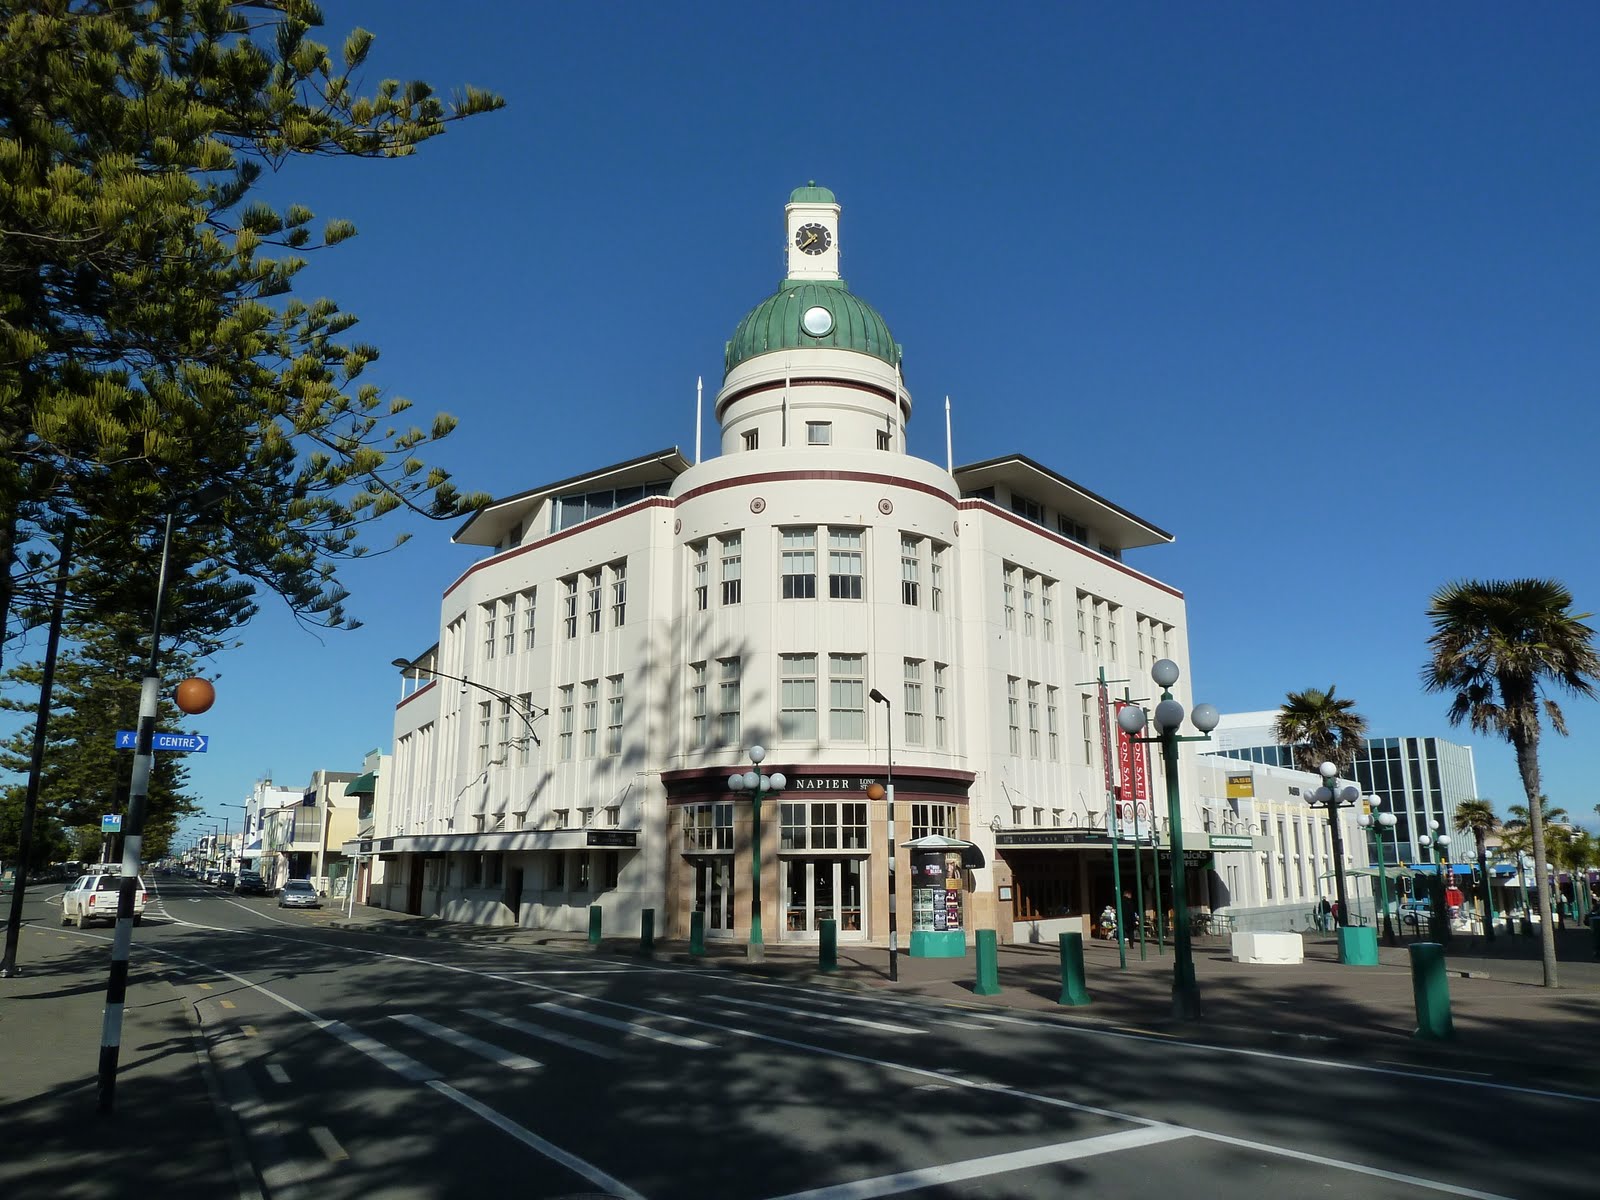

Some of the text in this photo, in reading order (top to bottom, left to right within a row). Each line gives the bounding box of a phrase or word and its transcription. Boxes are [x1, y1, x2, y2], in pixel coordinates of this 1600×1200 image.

[160, 737, 195, 748] CENTRE
[1122, 741, 1128, 762] ON
[796, 779, 850, 789] NAPIER
[1124, 767, 1132, 798] SALE
[1160, 852, 1208, 860] STBUCKS
